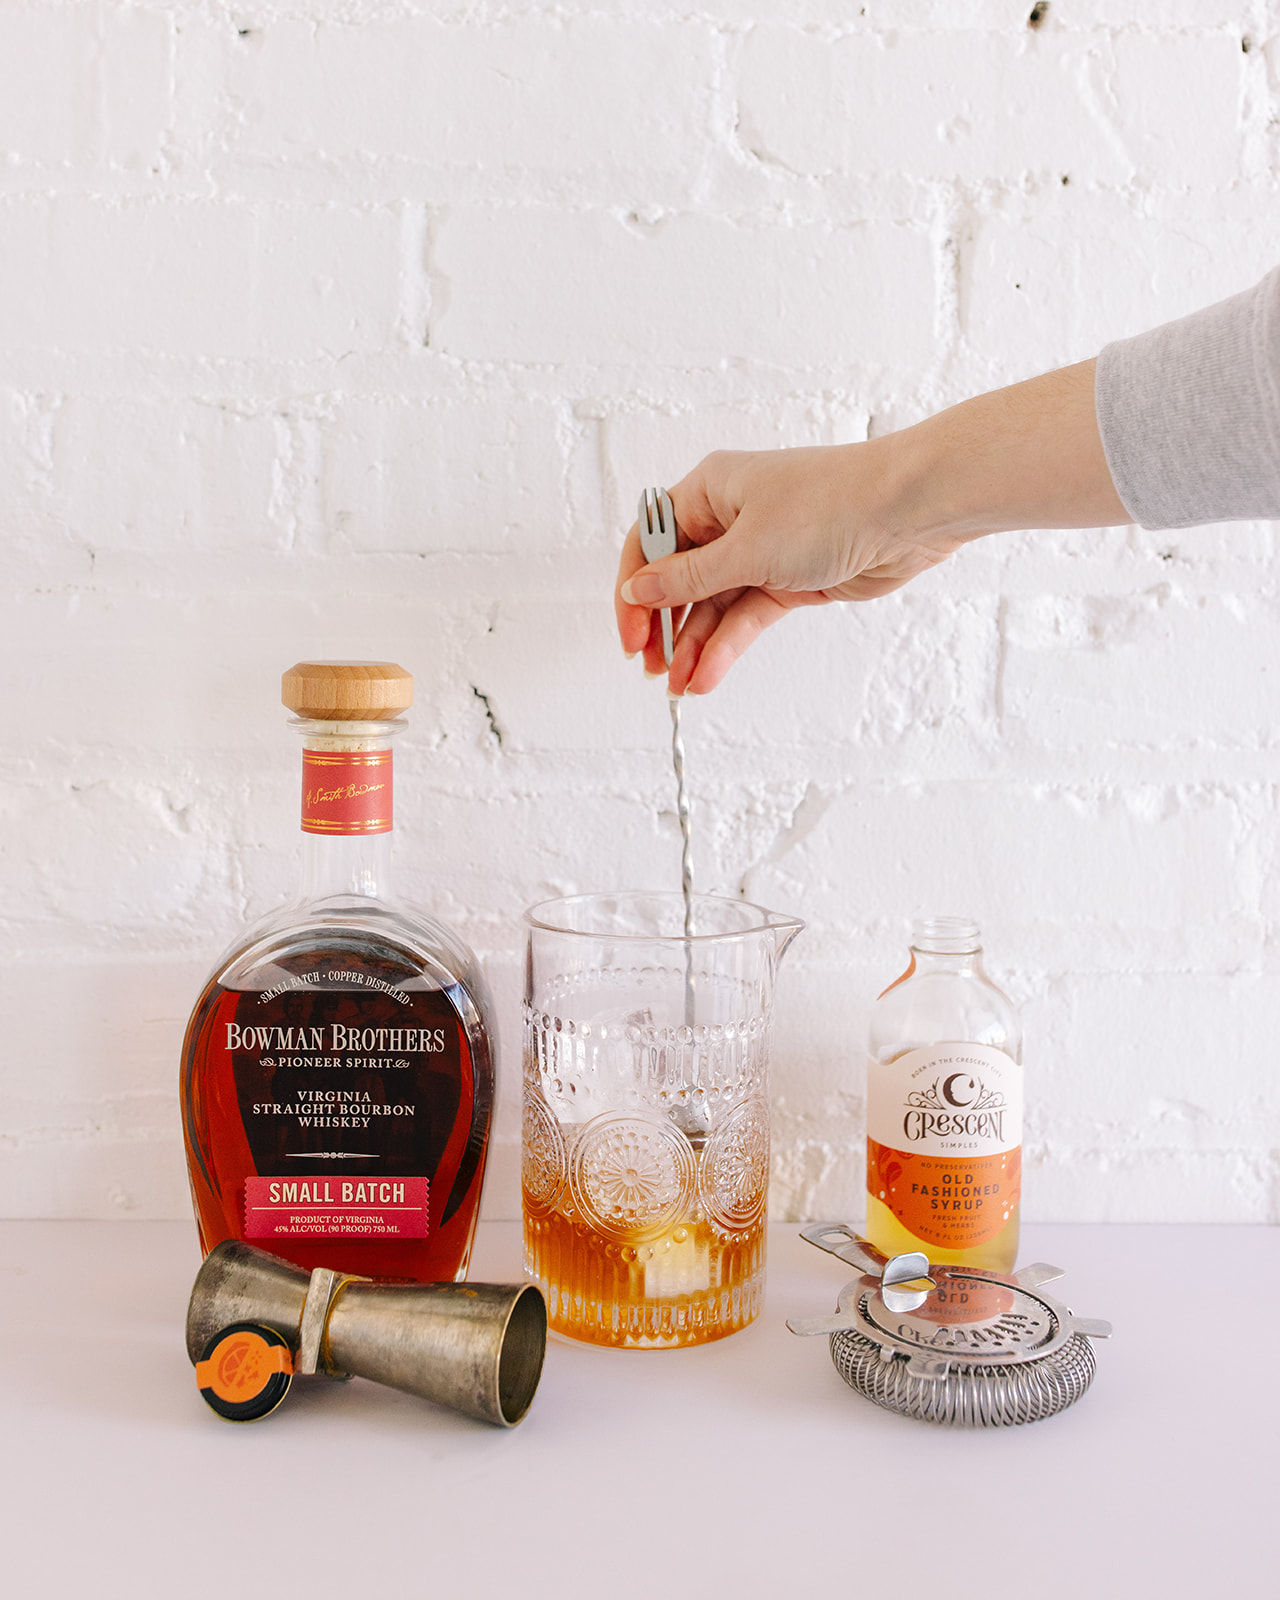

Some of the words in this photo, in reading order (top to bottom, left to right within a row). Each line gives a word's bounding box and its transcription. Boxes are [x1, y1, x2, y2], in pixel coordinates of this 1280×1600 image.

[260, 980, 291, 1004] SMALL
[290, 971, 320, 988] BATCH
[328, 970, 364, 985] COPPER
[365, 975, 410, 1006] DISTILLED
[224, 1022, 326, 1051] BOWMAN
[330, 1023, 445, 1053] BROTHERS
[278, 1056, 342, 1068] PIONEER
[345, 1057, 394, 1069] SPIRIT
[911, 1065, 927, 1078] BORN
[955, 1056, 989, 1068] CRESCENT
[297, 1090, 372, 1103] VIRGINIA
[252, 1103, 335, 1115] STRAIGHT
[339, 1103, 416, 1116] BOURBON
[297, 1116, 371, 1128] WHISKEY
[940, 1141, 978, 1149] SIMPLES
[935, 1162, 992, 1170] PRESERVATIVES
[942, 1174, 974, 1185] OLD
[269, 1182, 334, 1203] SMALL
[341, 1182, 405, 1203] BATCH
[911, 1183, 1000, 1198] FASHIONED
[930, 1199, 983, 1210] SYRUP
[290, 1216, 331, 1224] PRODUCT
[332, 1216, 344, 1224] OF
[345, 1216, 384, 1224] VIRGINIA
[274, 1225, 289, 1233] 45%
[289, 1225, 328, 1233] ALC/VOL
[328, 1225, 340, 1234] (90
[340, 1225, 372, 1234] PROOF)
[373, 1225, 386, 1233] 750
[386, 1225, 400, 1233] ML
[919, 1225, 933, 1235] NET
